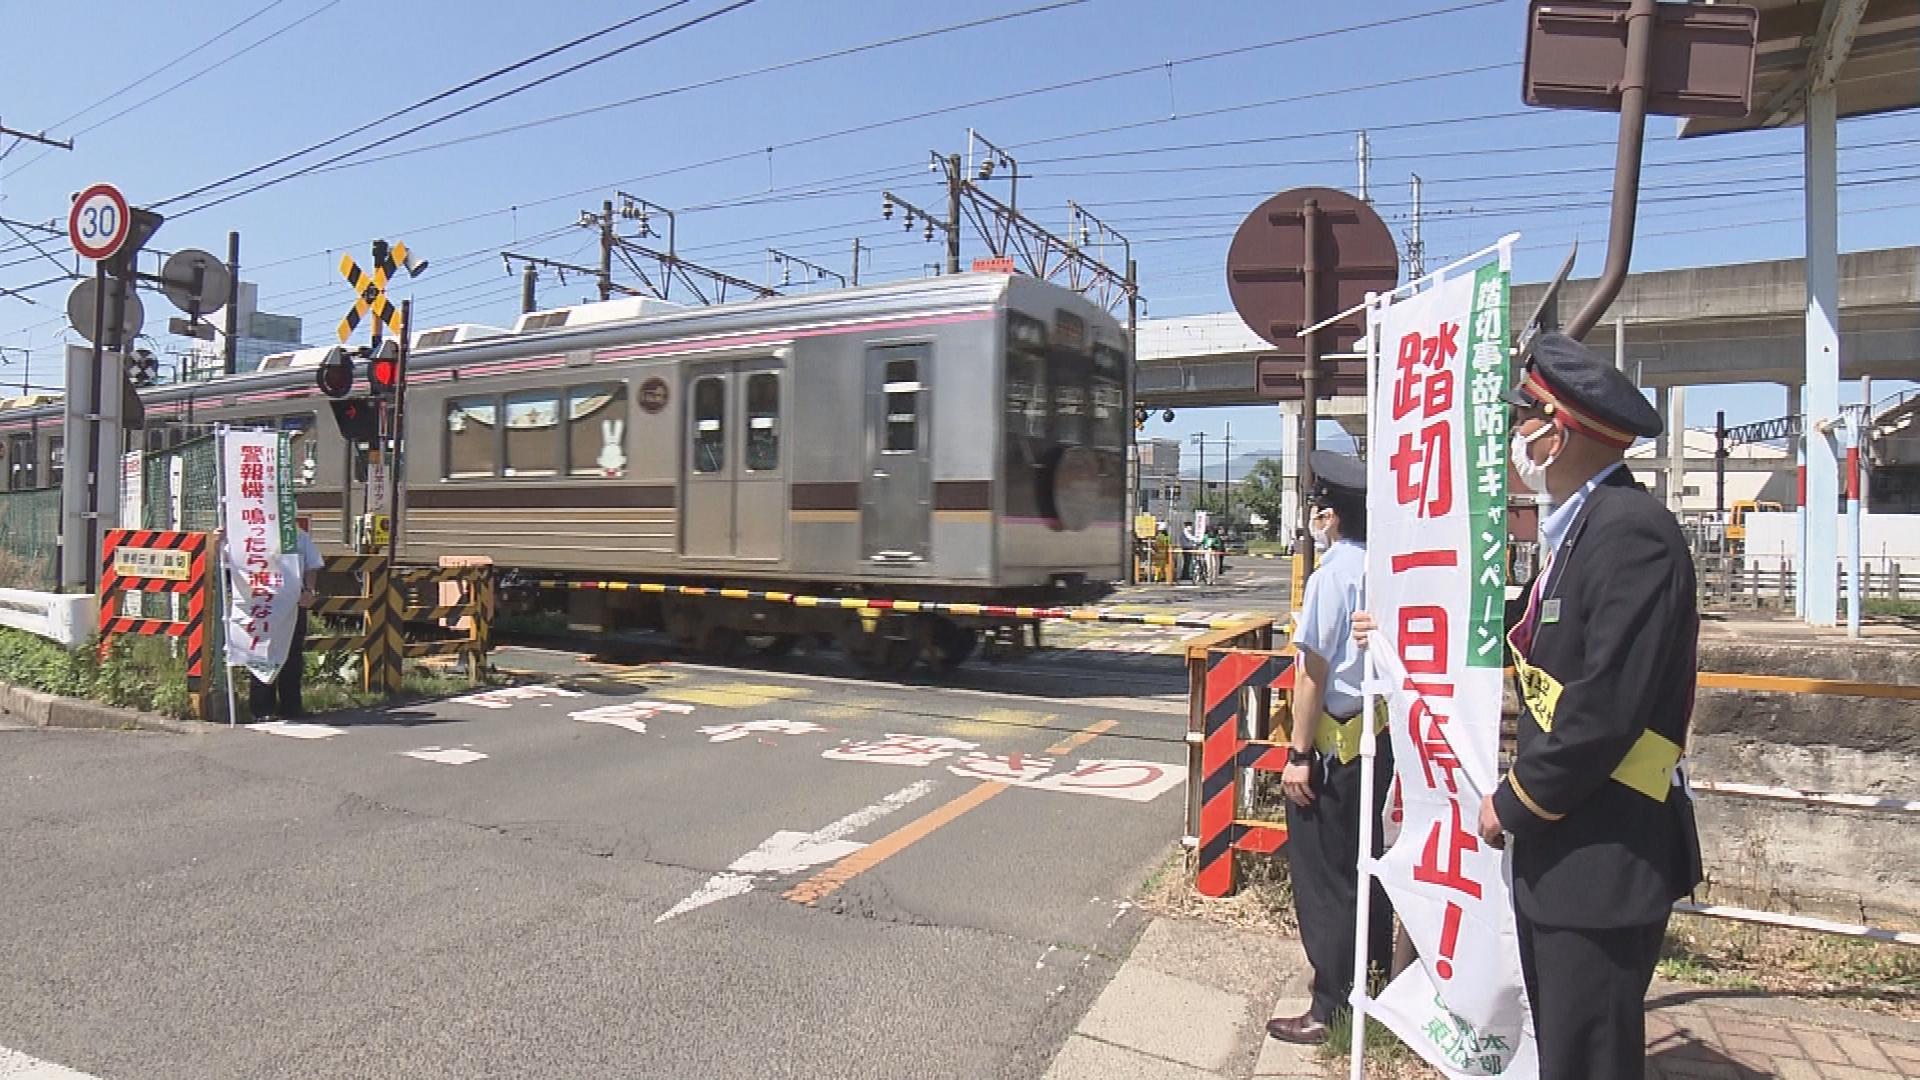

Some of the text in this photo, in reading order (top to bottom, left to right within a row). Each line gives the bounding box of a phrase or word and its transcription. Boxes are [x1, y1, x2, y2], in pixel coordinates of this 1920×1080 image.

[82, 205, 116, 239] 30
[1471, 277, 1504, 657] 踏切事故防止キャンペーン
